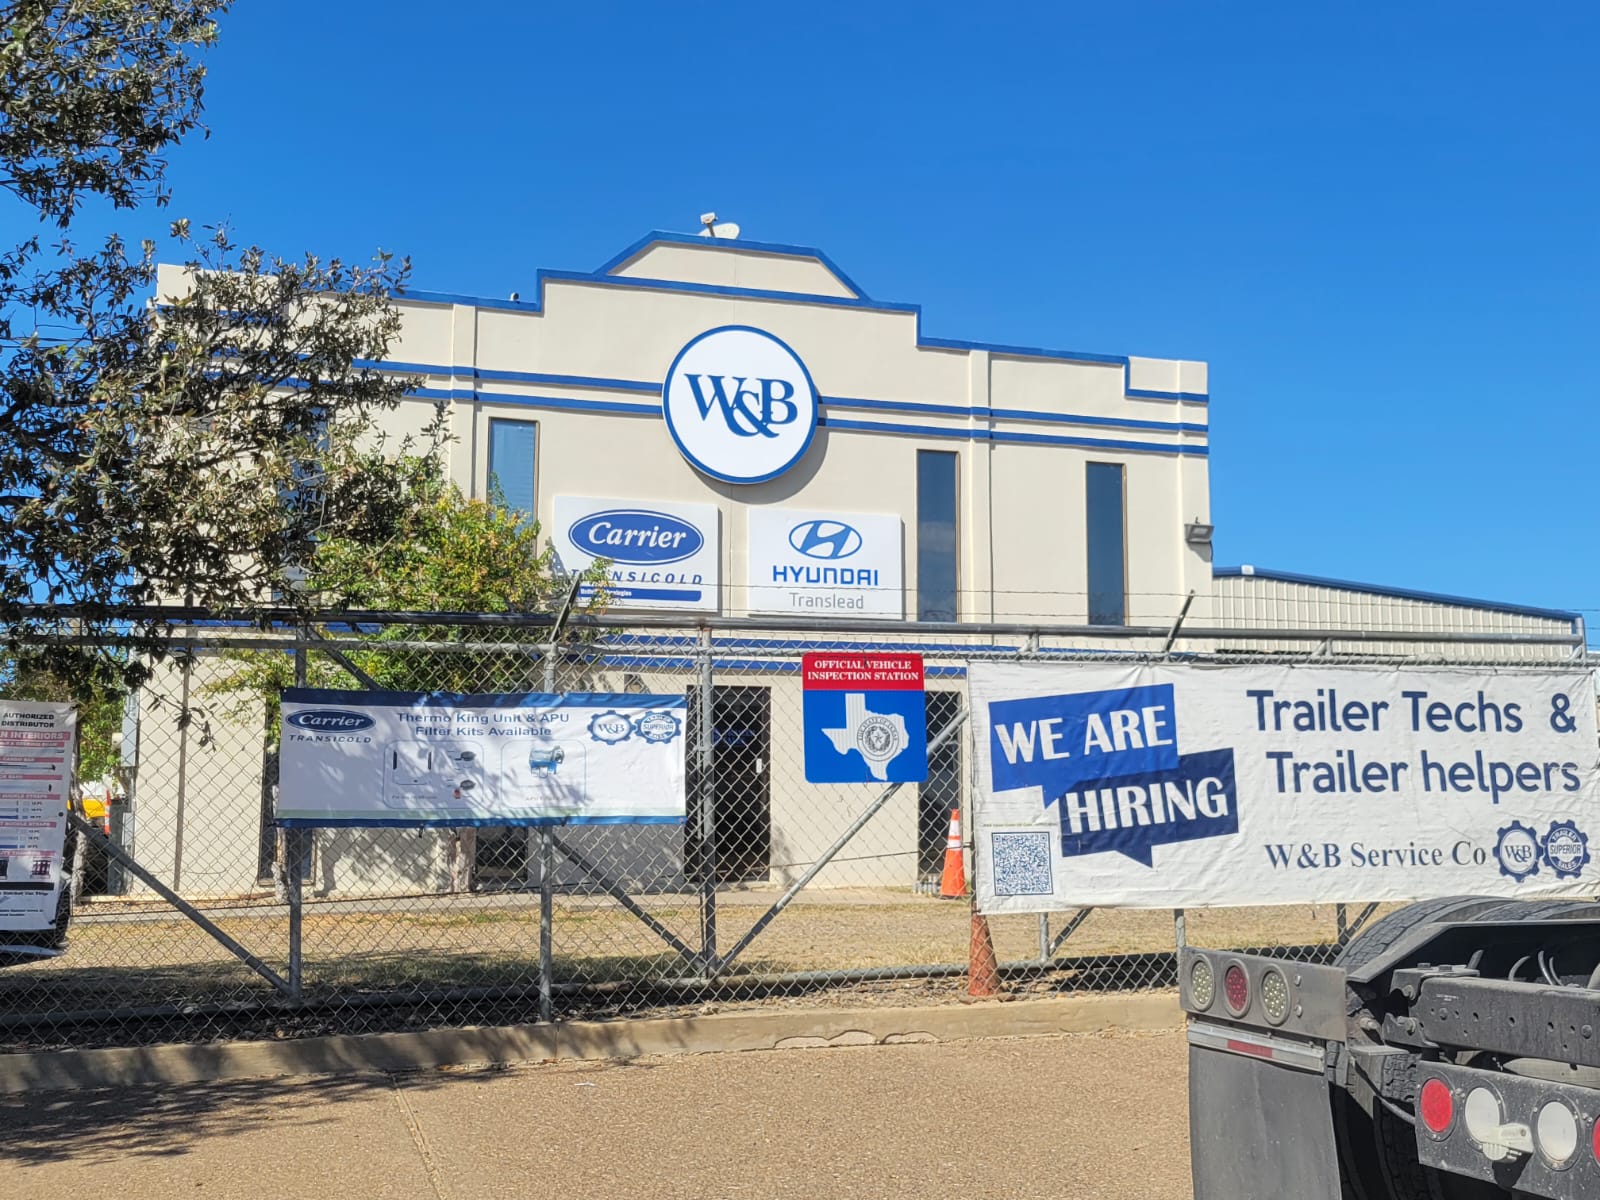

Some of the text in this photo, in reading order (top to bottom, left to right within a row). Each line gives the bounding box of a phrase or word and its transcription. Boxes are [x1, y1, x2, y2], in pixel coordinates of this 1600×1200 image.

[683, 373, 798, 438] W&B
[588, 521, 687, 549] Carrier
[571, 568, 703, 585] TNSICOLD
[773, 565, 879, 586] HYUNDAI
[788, 592, 864, 609] Translead
[814, 660, 912, 670] OFFICIAL VEHICLE
[807, 671, 919, 681] INSPECTION STATION
[3, 712, 55, 720] AUTHORIZED
[1246, 688, 1577, 733] Trailer Techs &
[1, 720, 55, 728] DISTRIBUTOR
[298, 714, 364, 727] Carrier
[397, 712, 570, 726] Thermo King Unit & APU
[11, 732, 64, 740] INTERIORS
[415, 726, 552, 737] Filter Kits Available
[598, 723, 625, 734] W&B
[994, 705, 1173, 765] WE ARE
[289, 734, 372, 744] TRANSICOLD
[1266, 750, 1582, 804] Trailer helpers
[1065, 776, 1229, 834] HIRING
[1264, 840, 1487, 869] W&B Service Co
[1504, 844, 1532, 863] W&B
[1549, 844, 1582, 855] SUPERIOR
